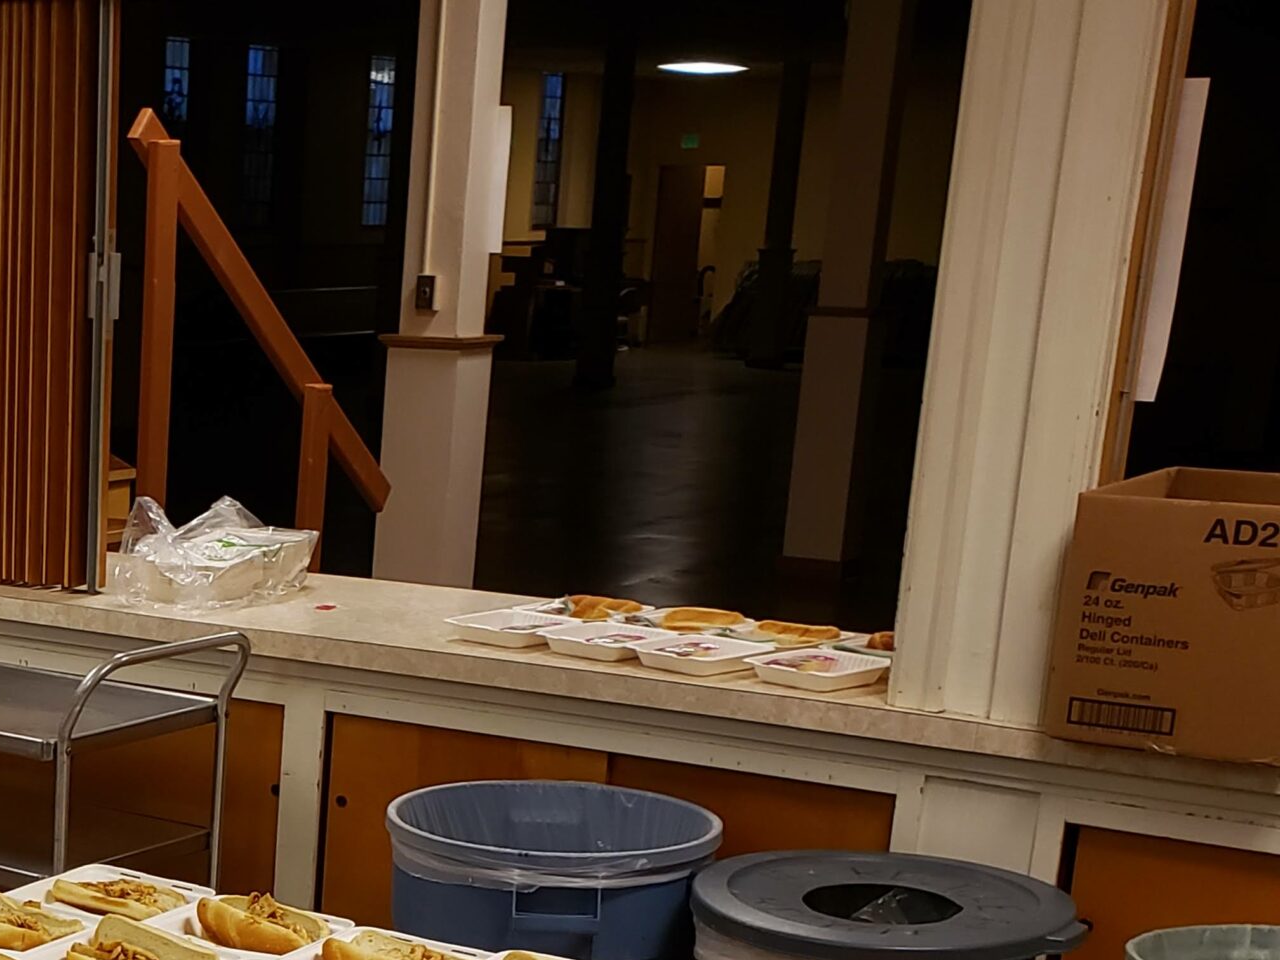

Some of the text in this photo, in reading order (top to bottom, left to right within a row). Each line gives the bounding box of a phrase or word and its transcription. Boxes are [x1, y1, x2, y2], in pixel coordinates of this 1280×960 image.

[1110, 578, 1179, 599] Genpak
[1083, 594, 1100, 607] 24
[1081, 611, 1132, 628] Hinged
[1080, 628, 1189, 650] Deli Containers
